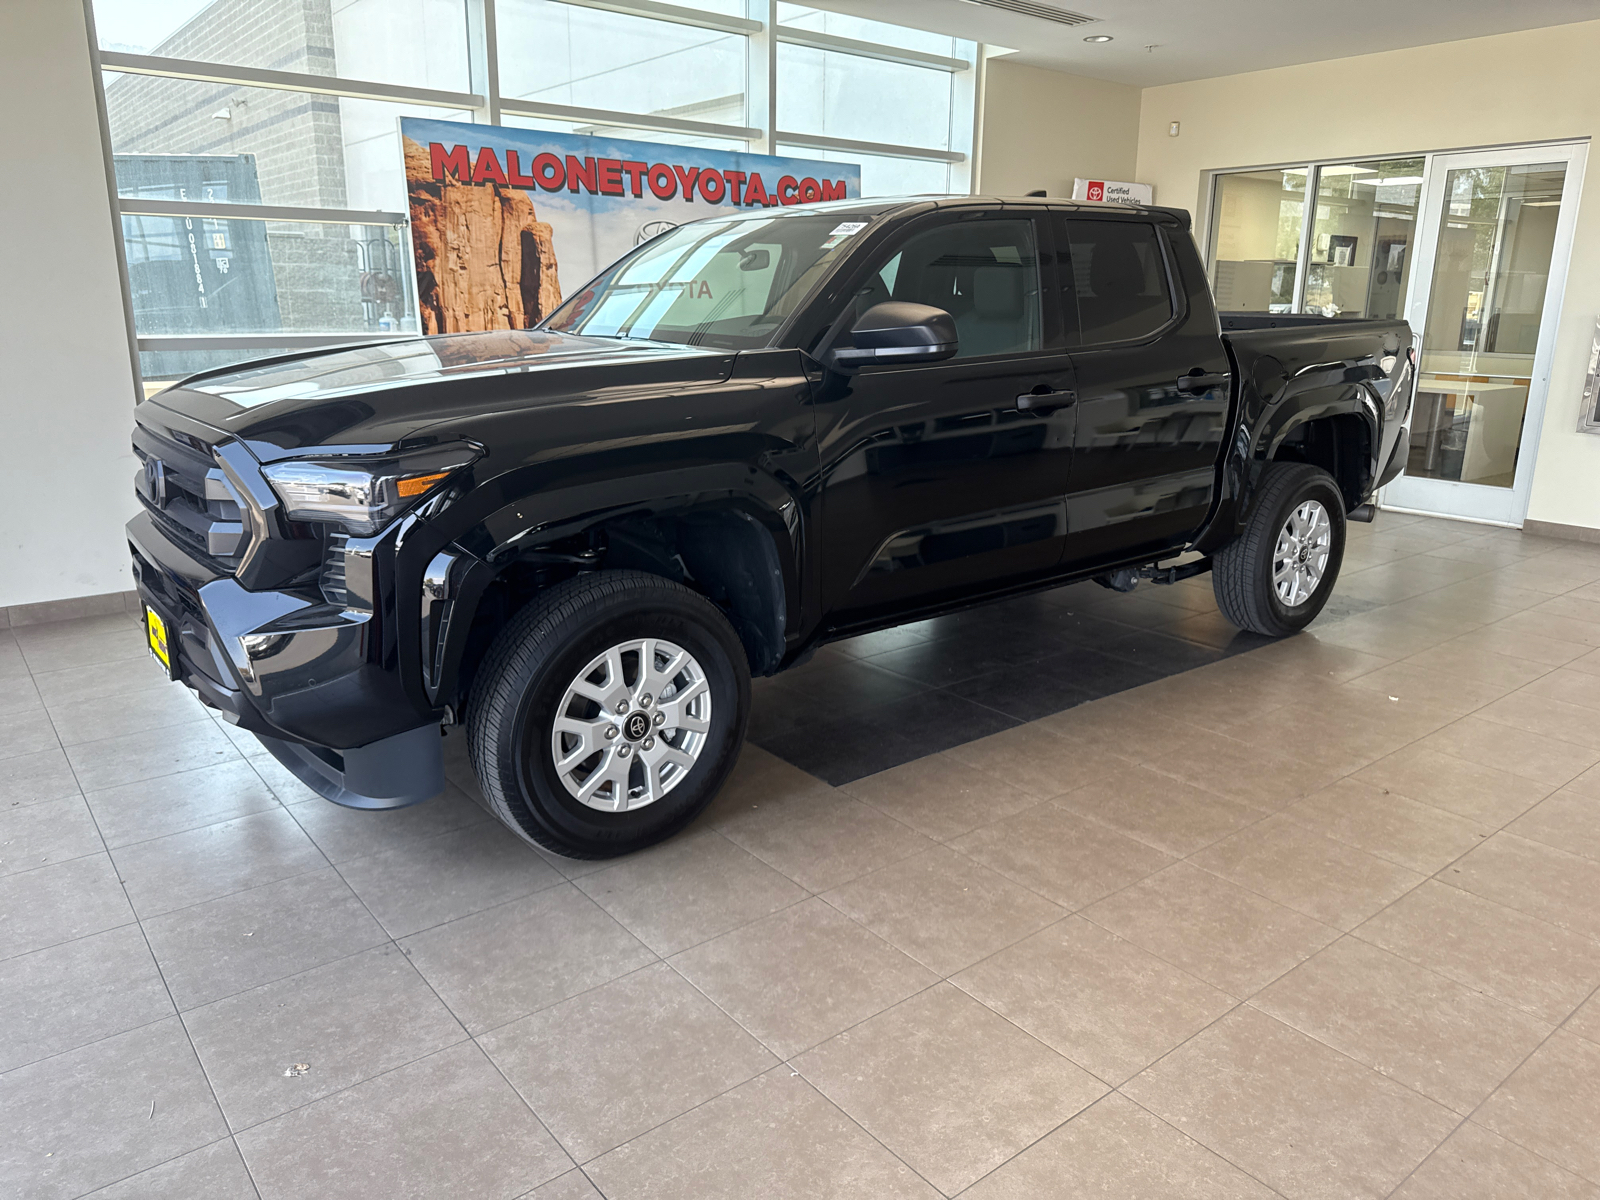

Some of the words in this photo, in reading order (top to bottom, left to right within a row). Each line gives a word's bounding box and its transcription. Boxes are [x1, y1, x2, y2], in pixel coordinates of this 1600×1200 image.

[428, 141, 847, 207] MALONETOYOTA.COM
[1107, 186, 1130, 195] Certified
[1106, 195, 1120, 203] Used
[1121, 196, 1141, 205] Vehicles
